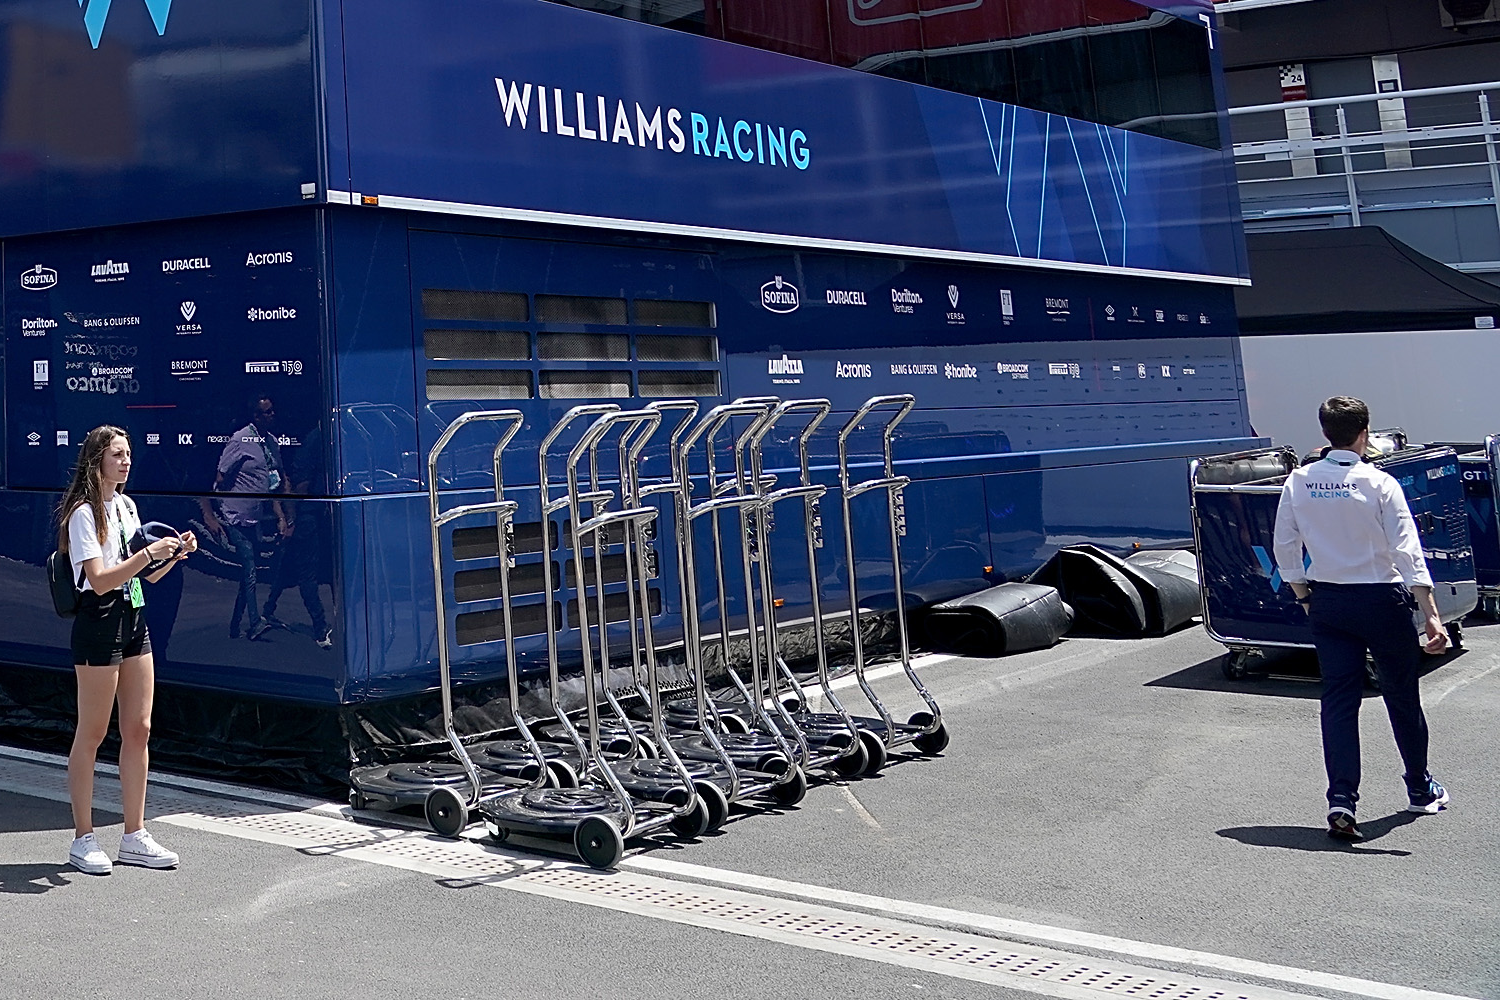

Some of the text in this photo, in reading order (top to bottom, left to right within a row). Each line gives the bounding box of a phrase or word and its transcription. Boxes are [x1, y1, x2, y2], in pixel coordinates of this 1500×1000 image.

[1291, 74, 1302, 83] 24
[162, 257, 211, 272] DURACELL
[246, 251, 293, 266] Acronis
[91, 260, 129, 276] LAVAZZA
[24, 274, 55, 285] SOFINA
[764, 291, 796, 304] SOFINA
[826, 290, 867, 305] DURACELL
[258, 307, 296, 320] honibe
[946, 312, 965, 320] VERSA
[84, 317, 140, 327] BANG & OLUFSEN
[171, 360, 208, 370] BREMONT
[246, 361, 302, 375] PIRELLI 150
[768, 354, 804, 374] LAVAZZA
[836, 361, 871, 378] Acronis
[891, 364, 907, 374] BANG
[913, 364, 938, 374] OLUFSEN
[1002, 364, 1029, 372] BROADCOM
[99, 367, 133, 375] BROADCOM
[953, 364, 977, 378] honibe
[178, 434, 192, 445] KX
